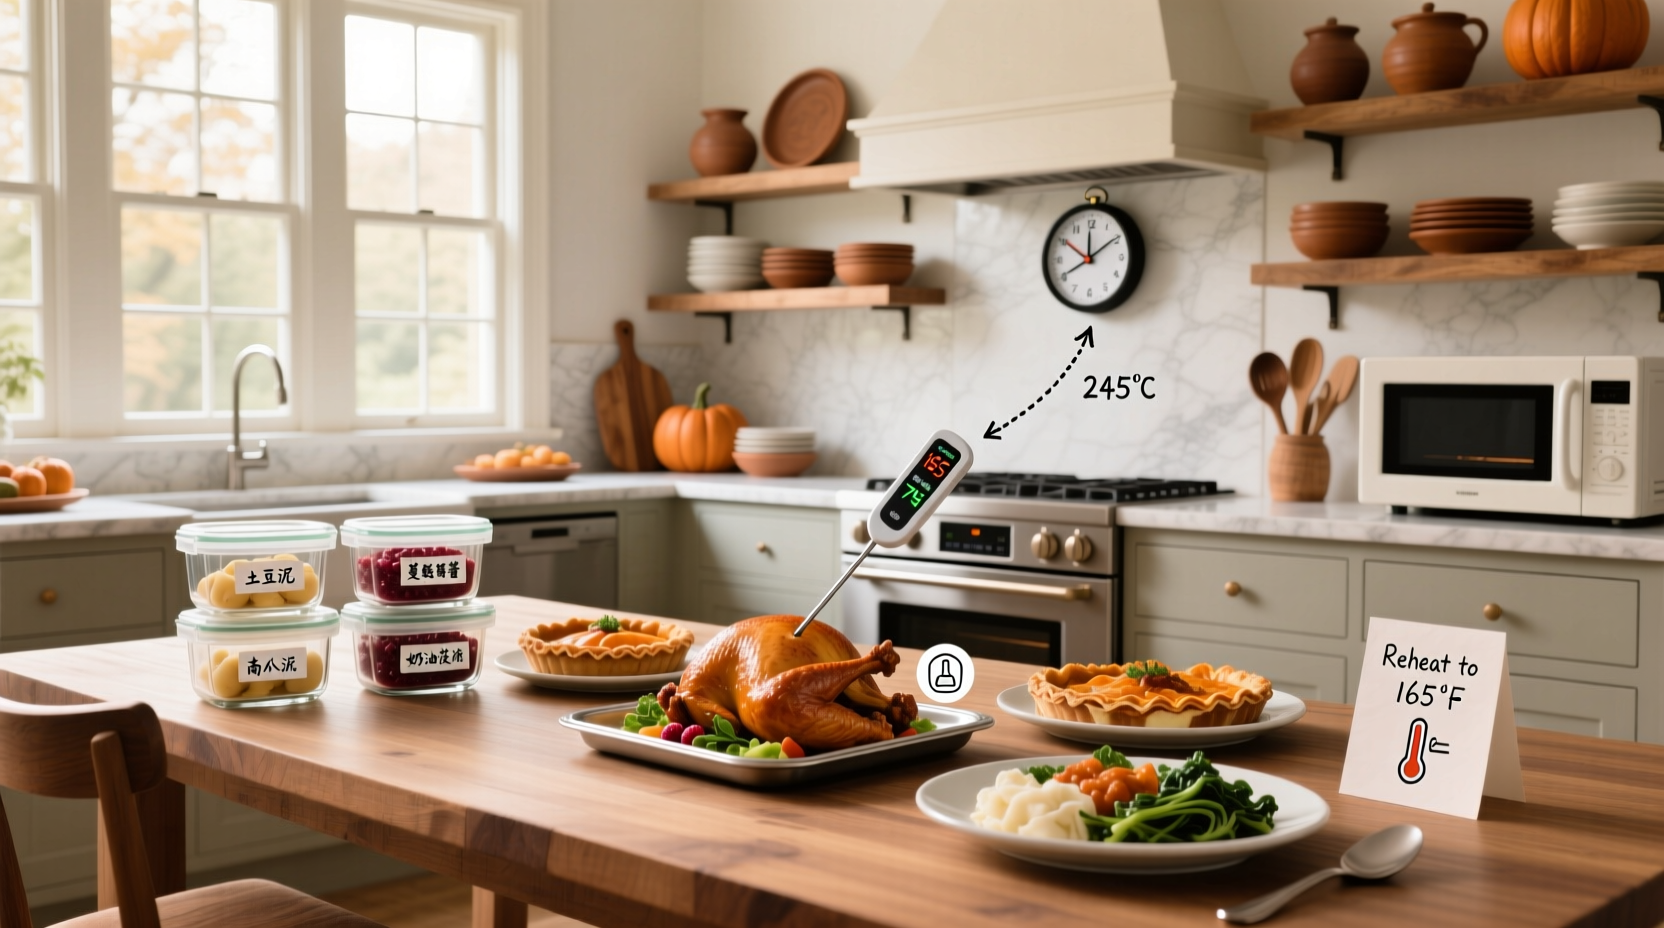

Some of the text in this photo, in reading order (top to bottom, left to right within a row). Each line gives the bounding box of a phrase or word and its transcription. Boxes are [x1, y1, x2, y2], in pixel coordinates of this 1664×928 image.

[1382, 643, 1478, 676] Reheat to
[1396, 680, 1466, 710] 165°F
